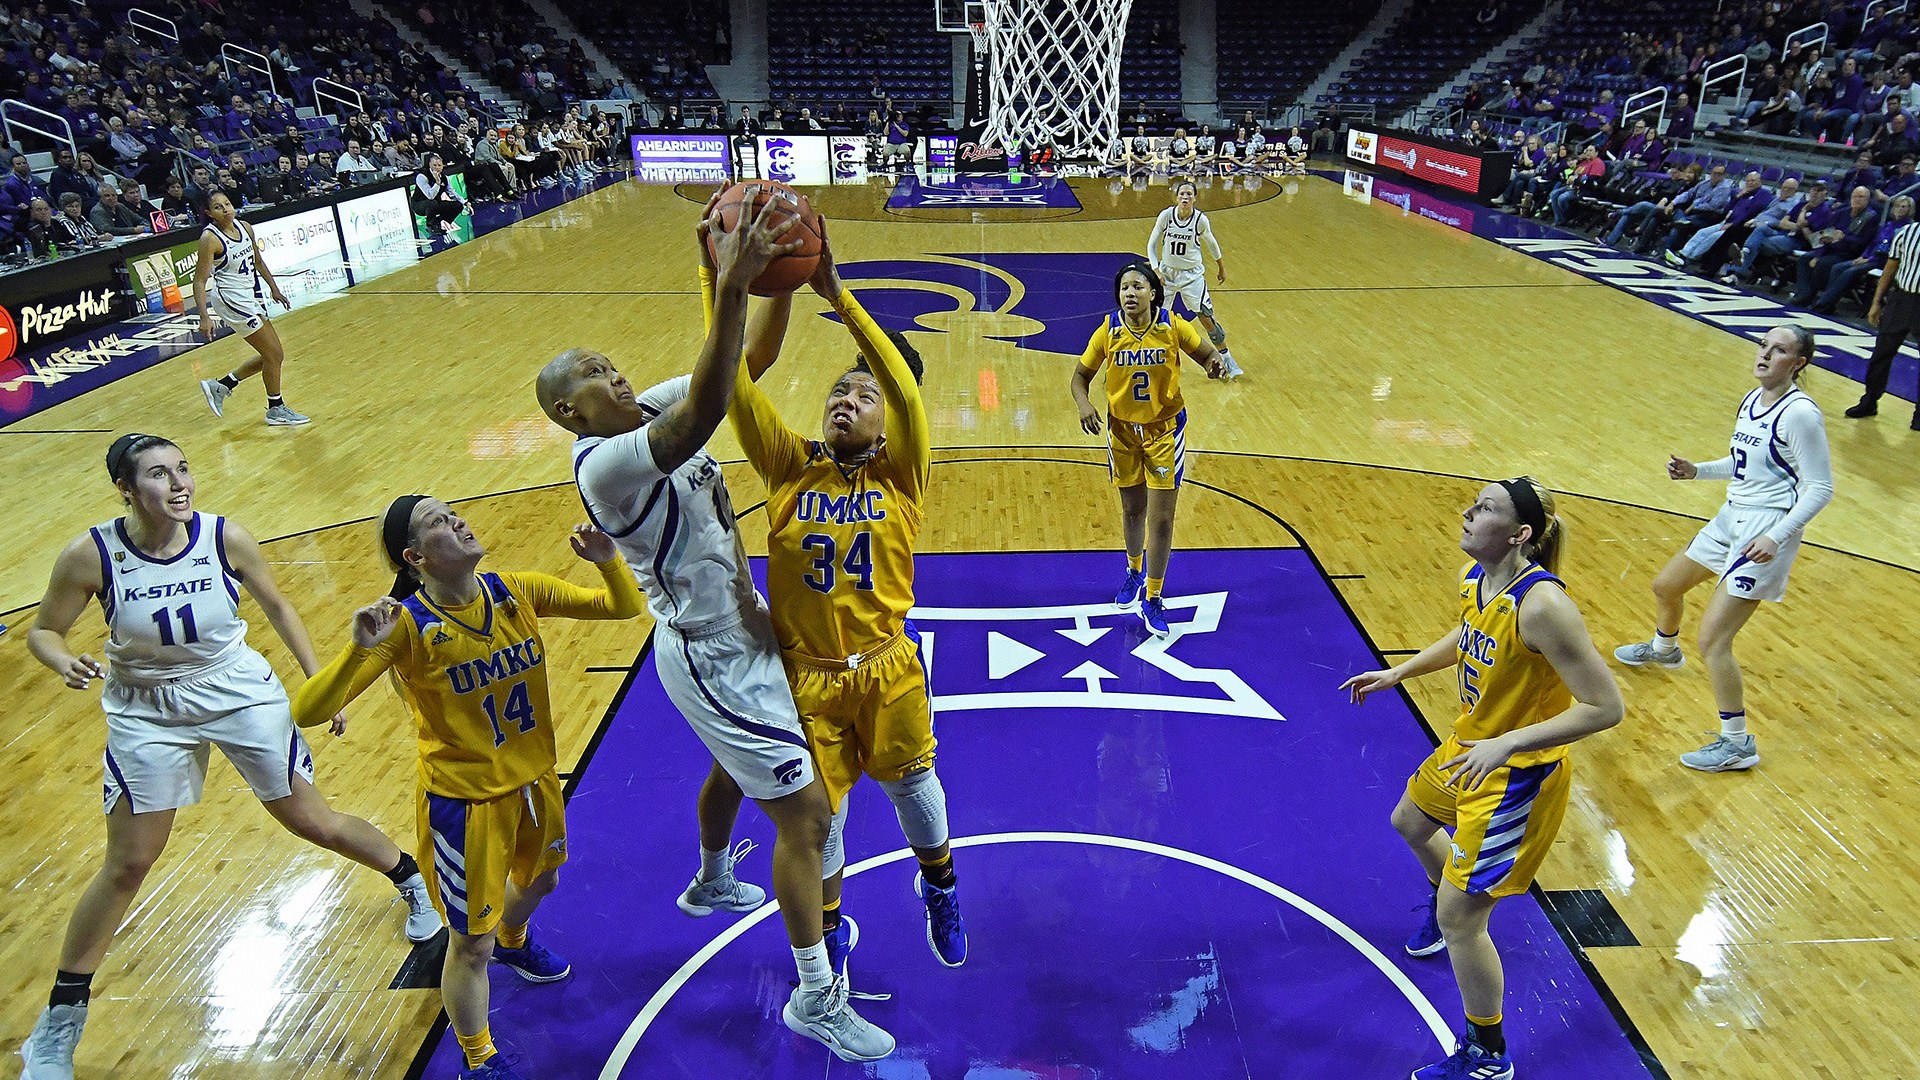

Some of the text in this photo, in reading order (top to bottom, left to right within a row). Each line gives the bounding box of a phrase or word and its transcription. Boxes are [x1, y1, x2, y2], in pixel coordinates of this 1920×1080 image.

[637, 141, 725, 151] AHEARNFUND
[362, 210, 376, 226] Via
[257, 232, 284, 252] OINTE
[296, 220, 335, 246] DISTRICT
[1167, 232, 1193, 241] K-STATE
[1170, 241, 1187, 256] 10
[175, 251, 199, 273] THAN
[239, 254, 255, 276] 43
[21, 304, 77, 344] Pizza
[76, 288, 115, 321] Hut
[1114, 348, 1166, 367] UMKC
[1132, 370, 1152, 402] 2
[796, 490, 886, 525] UMKC
[801, 531, 875, 595] 34
[124, 577, 213, 602] K-STATE
[151, 603, 200, 646] 11
[445, 636, 542, 694] UMKC
[481, 680, 537, 750] 14
